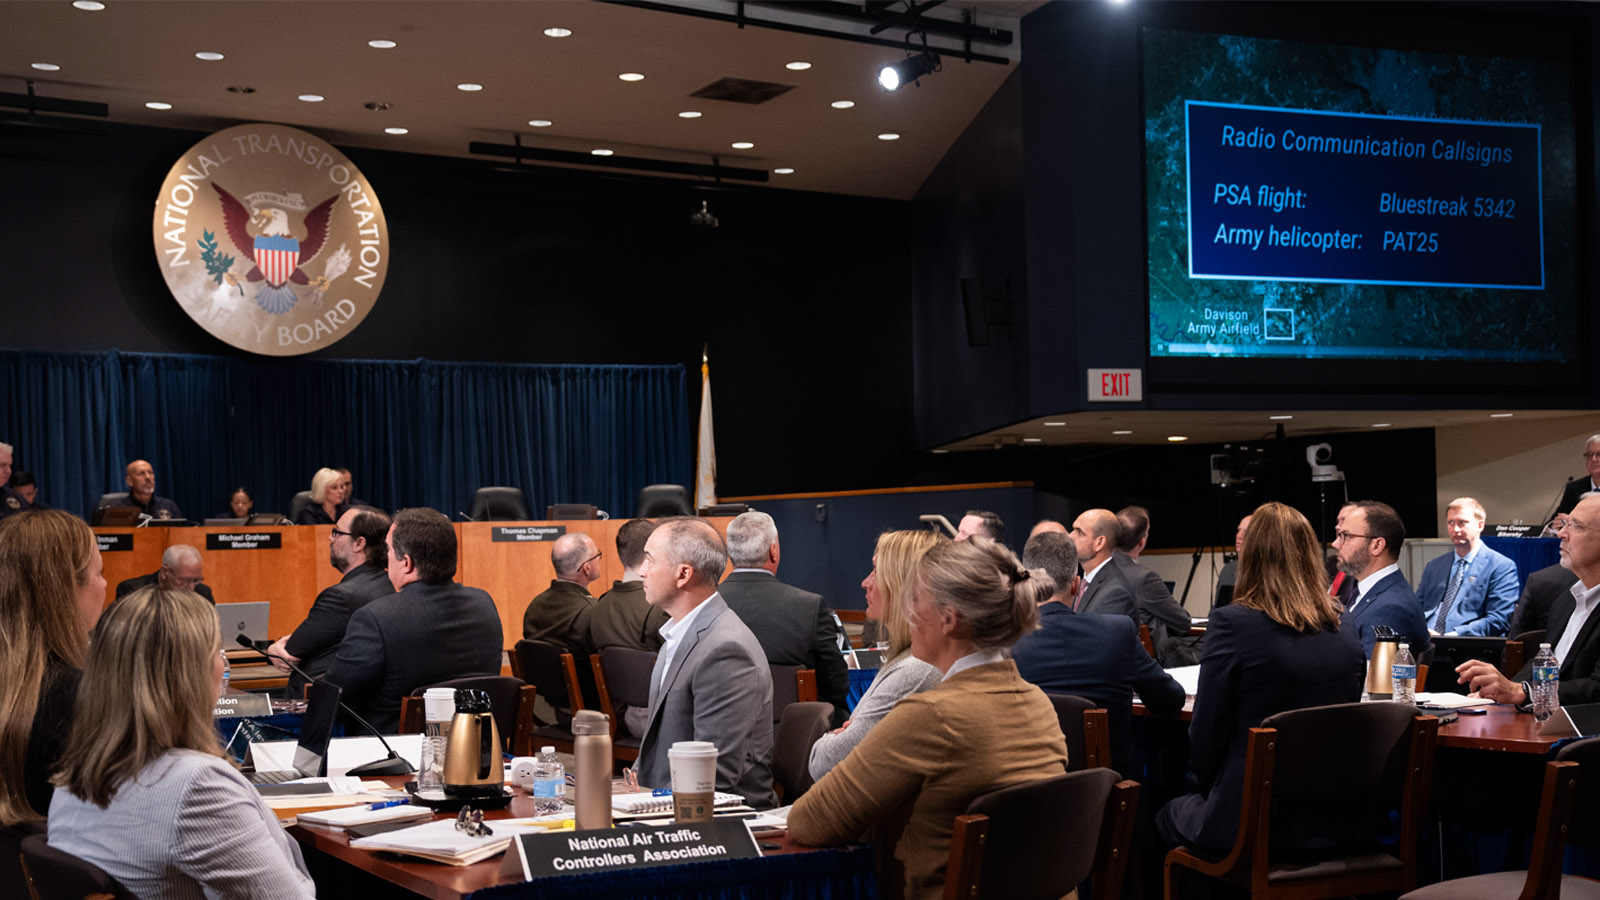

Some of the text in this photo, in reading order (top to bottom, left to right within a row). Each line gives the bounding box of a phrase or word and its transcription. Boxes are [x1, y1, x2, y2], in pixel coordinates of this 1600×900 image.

[1221, 125, 1513, 167] Radio Communication Callsigns
[1213, 183, 1307, 213] PSA flight:
[1379, 192, 1516, 219] Bluestreak 5342
[164, 134, 381, 289] NATIONAL TRANSPORTATION
[1213, 223, 1363, 253] Army helicopter:
[1382, 230, 1439, 253] PAT25
[277, 298, 356, 347] BOARD
[1204, 307, 1248, 320] Davison
[1187, 321, 1260, 337] Army Airfield
[1102, 373, 1131, 396] EXIT
[218, 533, 271, 542] Michael Graham
[215, 697, 238, 705] tion
[568, 829, 701, 851] National Air Traffic
[552, 843, 727, 871] Controllers Association
